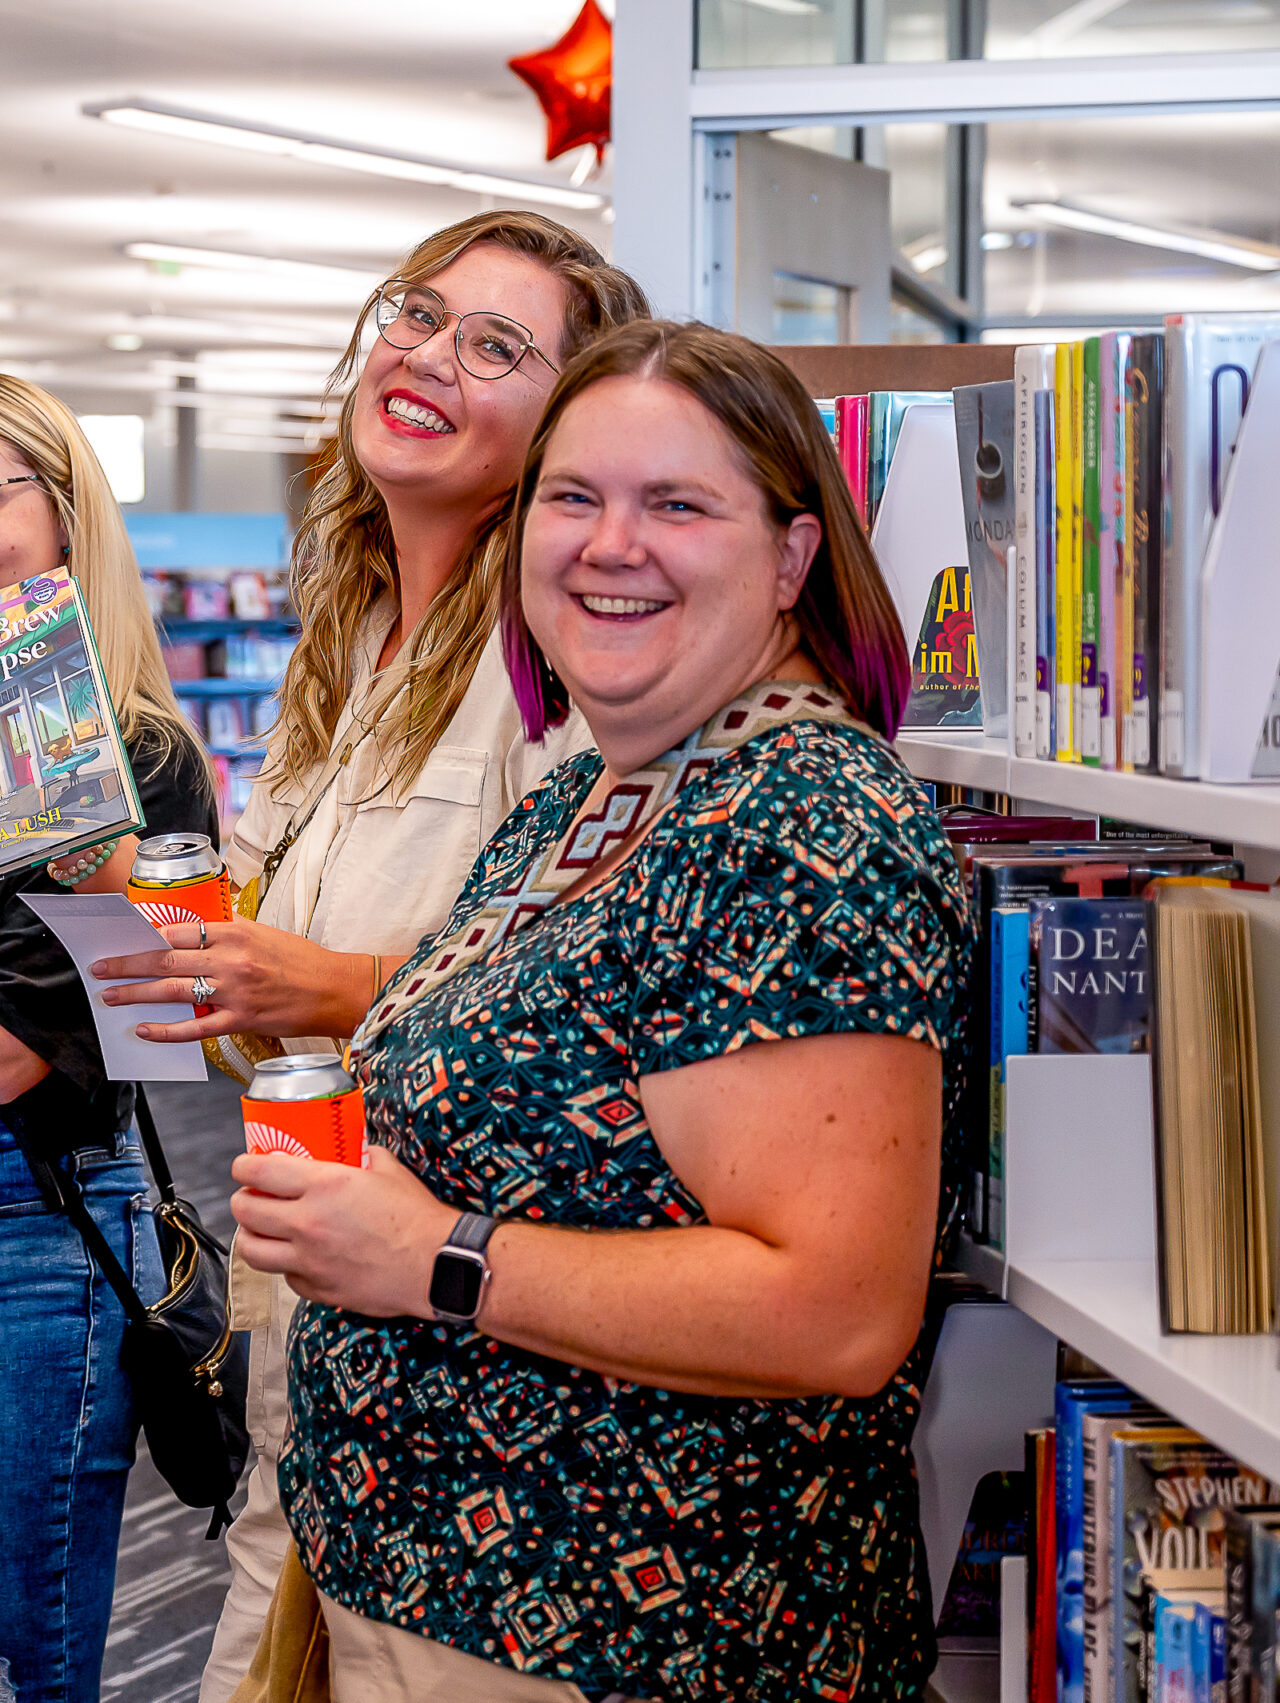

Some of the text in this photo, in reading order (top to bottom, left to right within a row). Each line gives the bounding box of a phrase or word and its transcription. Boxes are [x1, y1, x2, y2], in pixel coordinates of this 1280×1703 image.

[1020, 556, 1028, 629] COLUM
[919, 682, 980, 692] author of The
[14, 806, 62, 837] LUSH
[1051, 927, 1148, 961] DEA
[1052, 970, 1147, 996] NANT
[1155, 1476, 1264, 1512] STEPHEN
